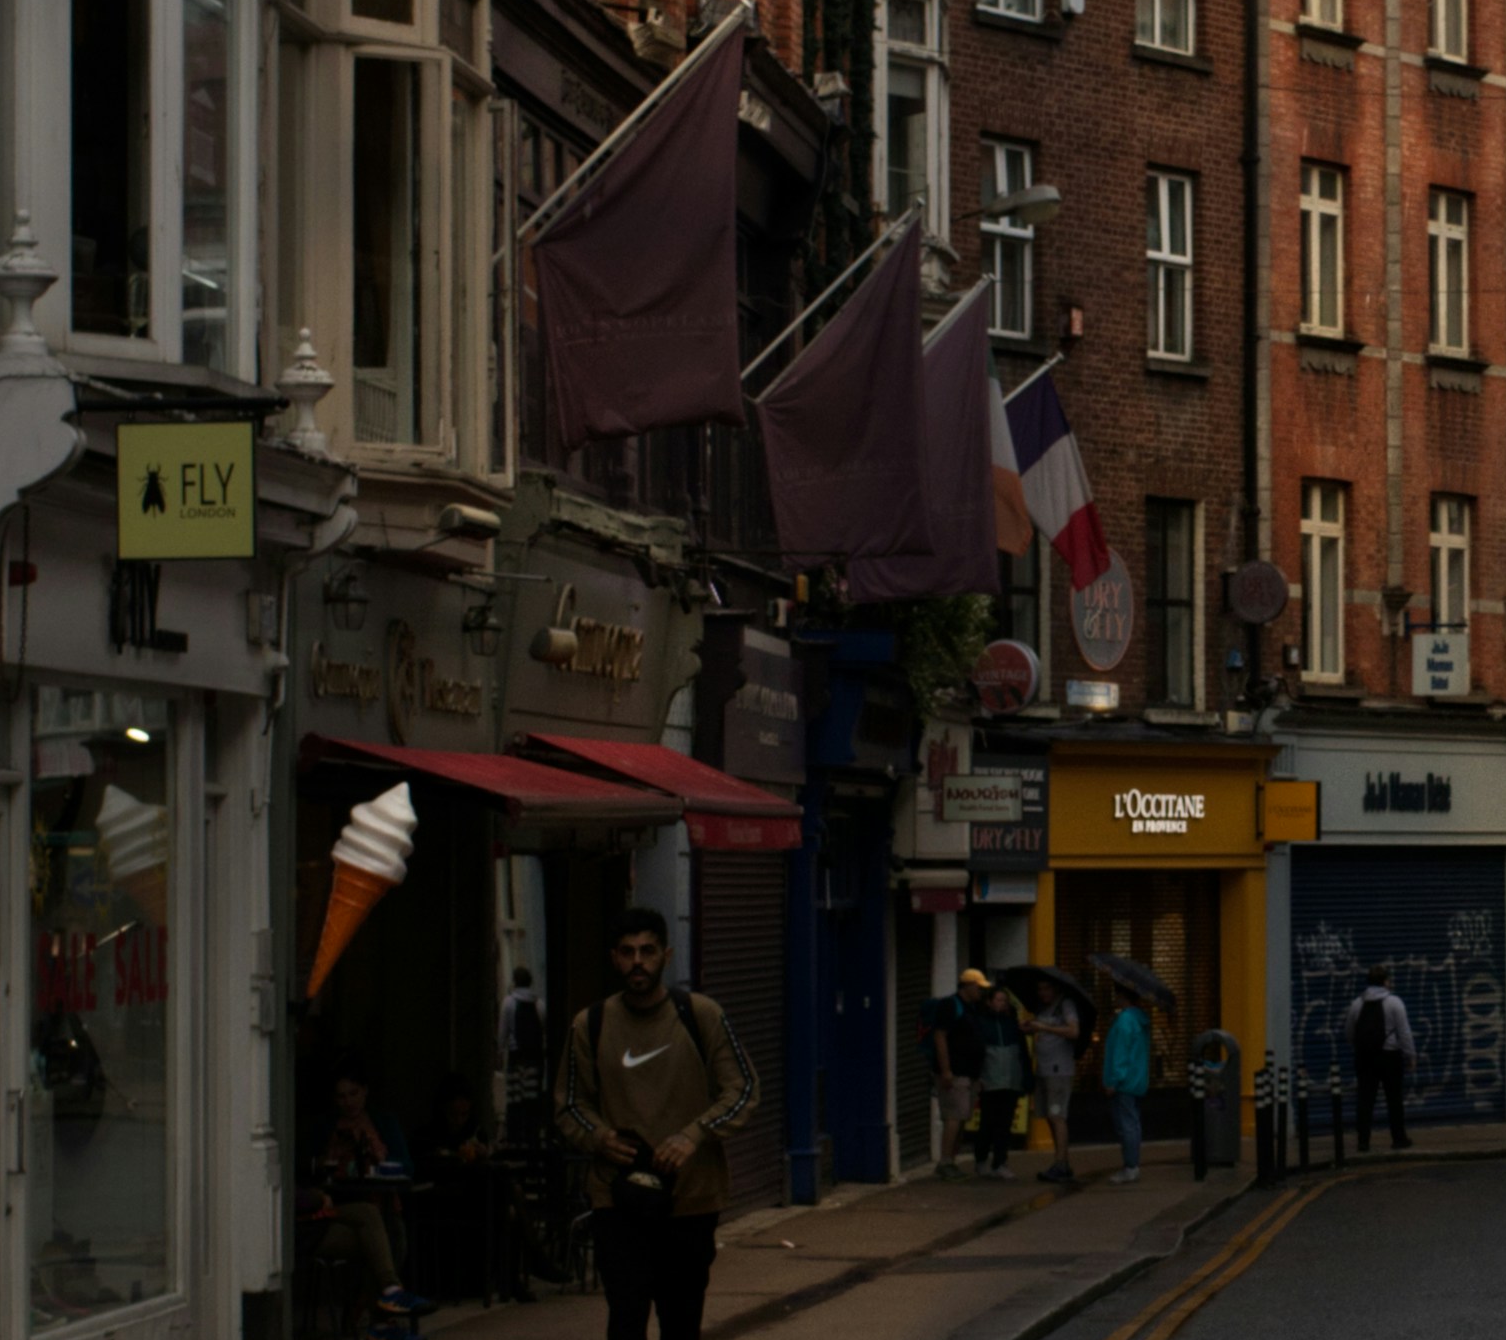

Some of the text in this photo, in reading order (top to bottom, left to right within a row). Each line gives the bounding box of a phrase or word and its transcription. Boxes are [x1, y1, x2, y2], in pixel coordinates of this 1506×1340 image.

[181, 462, 235, 506] FLY
[179, 507, 236, 519] LONDON
[1084, 580, 1123, 609] DRY
[1113, 787, 1206, 820] L'OCCITANE
[972, 825, 1003, 852] DRY
[1015, 826, 1043, 852] FLY
[36, 925, 169, 1014] SALE SALE
